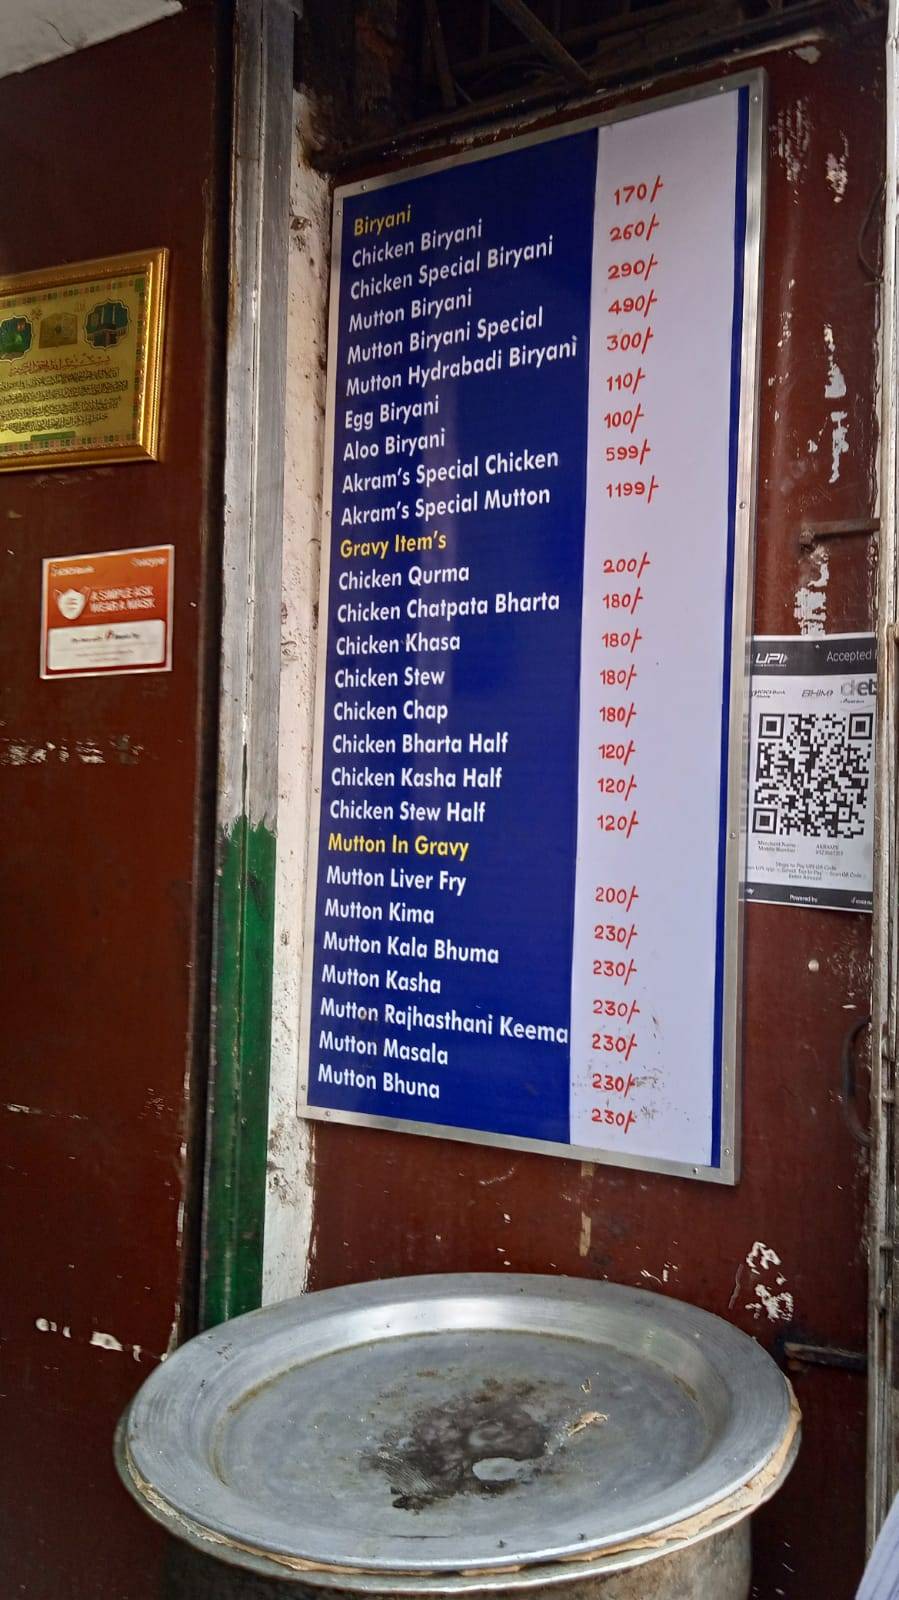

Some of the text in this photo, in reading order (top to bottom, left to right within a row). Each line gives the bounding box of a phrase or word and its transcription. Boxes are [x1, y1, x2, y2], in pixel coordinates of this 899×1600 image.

[613, 175, 665, 208] 170/-
[354, 204, 411, 236] Biryani
[608, 213, 660, 242] 260/-
[353, 218, 482, 267] Chicken Biryani
[351, 234, 553, 300] Chicken Special Biryani
[607, 255, 658, 283] 290/-
[349, 287, 472, 332] Mutton Biryani
[607, 287, 657, 321] 490/-
[347, 306, 543, 364] Mutton Biryani Special
[607, 326, 655, 355] 300/-
[346, 335, 577, 396] Mutton Hydrabadi Biryani
[607, 367, 646, 395] 110/-
[345, 394, 439, 432] Egg Biryani
[602, 403, 643, 433] 100/-
[344, 427, 445, 461] Aloo Biryani
[604, 438, 652, 465] 599/-
[342, 449, 558, 493] Akram's Special Chicken
[606, 475, 658, 505] 1199/-
[341, 488, 550, 526] Akram's Special Mutton
[341, 530, 446, 559] Gravy Item's
[339, 566, 469, 590] Chicken Qurma
[602, 551, 652, 580] 200/-
[338, 592, 559, 623] Chicken Chatpata Bharta
[602, 586, 642, 614] 180/-
[336, 632, 461, 656] Chicken Khasa
[601, 627, 642, 652] 180/-
[756, 653, 784, 664] UPI
[826, 648, 872, 664] Accepted
[335, 667, 445, 688] Chicken Stew
[599, 666, 637, 689] 180/-
[334, 699, 448, 724] Chicken Chap
[599, 703, 636, 727] 180/-
[333, 731, 508, 753] Chicken Bharta Half
[598, 739, 636, 768] 120/-
[332, 767, 502, 788] Chicken Kasha Half
[596, 775, 638, 801] 120/-
[330, 799, 486, 822] Chicken Stew Half
[597, 810, 639, 838] 120/-
[328, 833, 469, 862] Mutton In Gravy
[327, 865, 466, 896] Mutton Liver Fry
[325, 898, 434, 924] Mutton Kima
[594, 886, 638, 912] 200/-
[323, 931, 499, 964] Mutton Kala Bhuma
[594, 923, 637, 948] 230/-
[322, 964, 441, 994] Mutton Kasha
[592, 959, 637, 985] 230/-
[320, 997, 567, 1043] Mutton Rajhasthani Keema
[592, 997, 641, 1024] 230/-
[319, 1030, 448, 1065] Mutton Masala
[591, 1032, 637, 1061] 230/-
[318, 1064, 439, 1099] Mutton Bhuna
[591, 1072, 636, 1096] 230/-
[591, 1107, 636, 1133] 230/-
